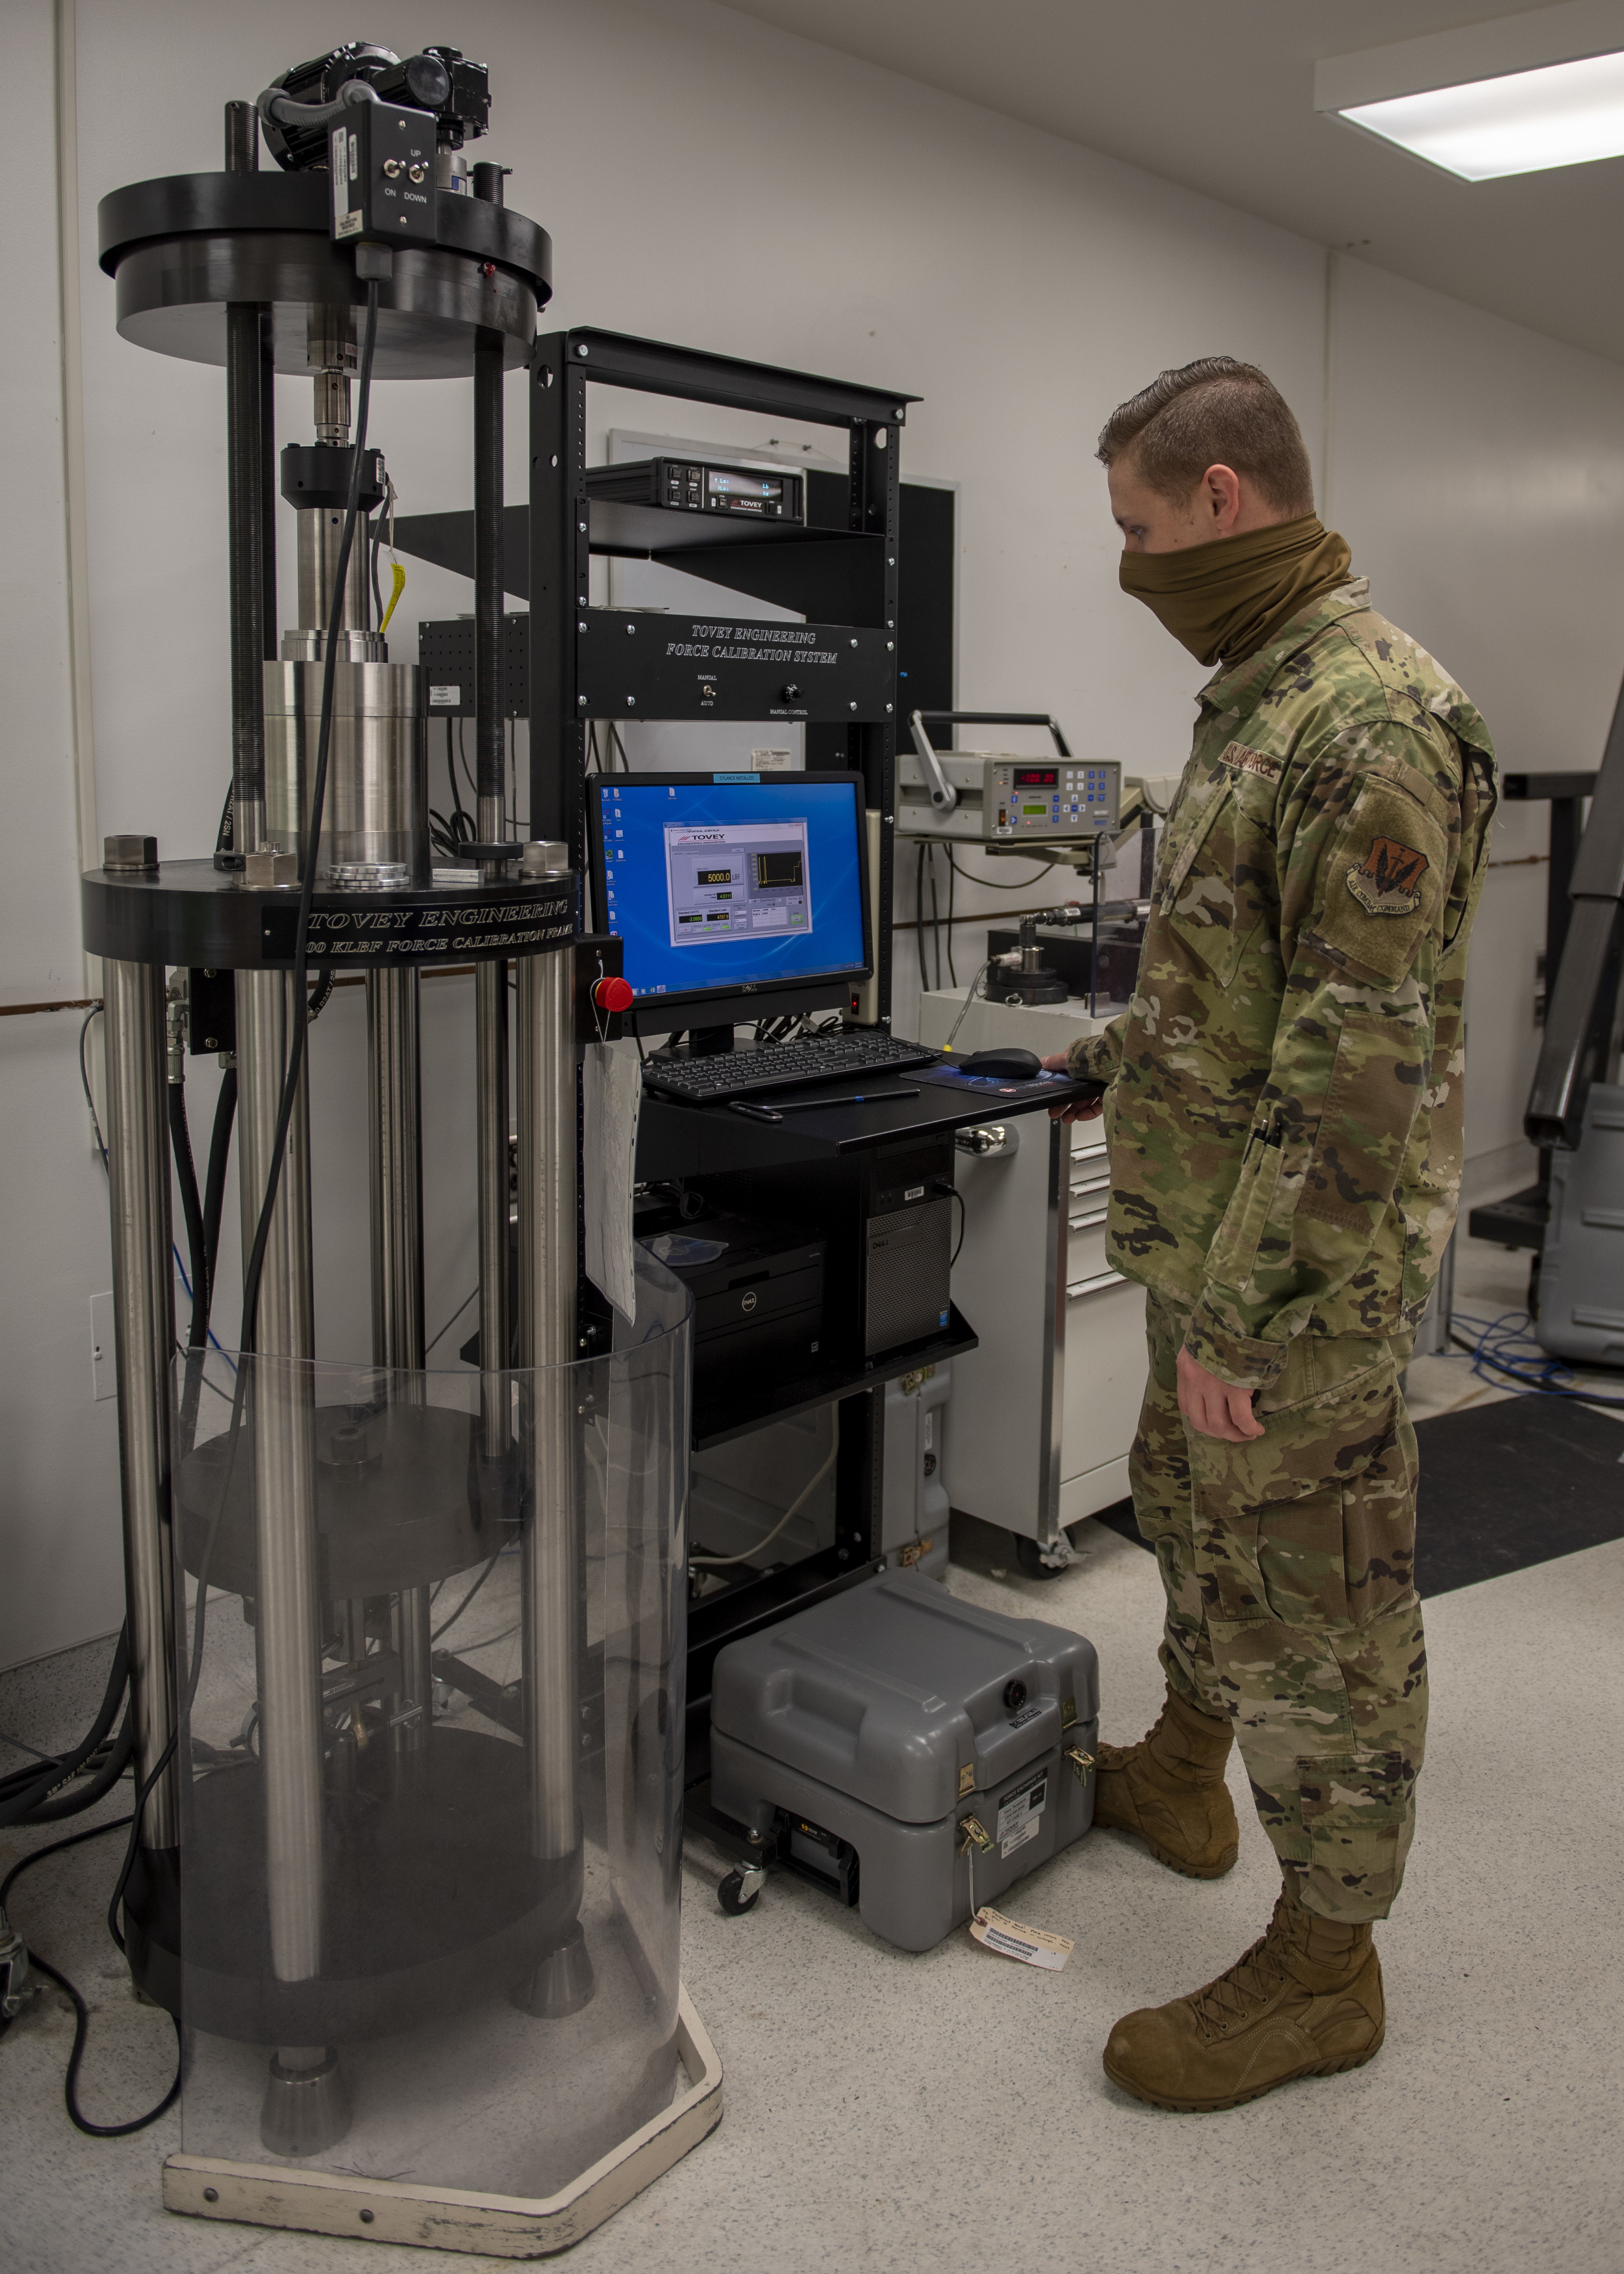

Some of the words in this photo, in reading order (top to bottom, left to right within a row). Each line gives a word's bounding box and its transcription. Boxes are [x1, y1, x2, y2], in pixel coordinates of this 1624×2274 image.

[411, 149, 421, 157] UP
[385, 188, 396, 197] ON
[404, 192, 427, 204] DOWN
[692, 625, 733, 639] TOVEY
[734, 628, 816, 644] ENGINEERING
[666, 643, 710, 657] FORCE
[712, 646, 793, 662] CALIBRATION
[793, 651, 838, 664] SYSTEM
[222, 821, 232, 837] 2SN
[708, 872, 730, 882] 5000.0
[1348, 880, 1359, 892] AIR
[1356, 891, 1377, 913] COMBAT
[1377, 904, 1410, 913] COMMAND
[308, 912, 413, 929] TOVEY
[418, 899, 568, 927] ENGINEERING
[330, 941, 383, 953] KLBF
[386, 938, 449, 952] FORCE
[452, 929, 545, 949] CALIBRATION
[545, 923, 574, 939] FRAME
[742, 984, 758, 993] DELL
[319, 986, 332, 1008] R2AT
[872, 1239, 890, 1250] DELL
[1004, 1789, 1017, 1802] FORCE
[1017, 1775, 1037, 1793] EXCHANGE
[1005, 1820, 1019, 1833] TOVEY
